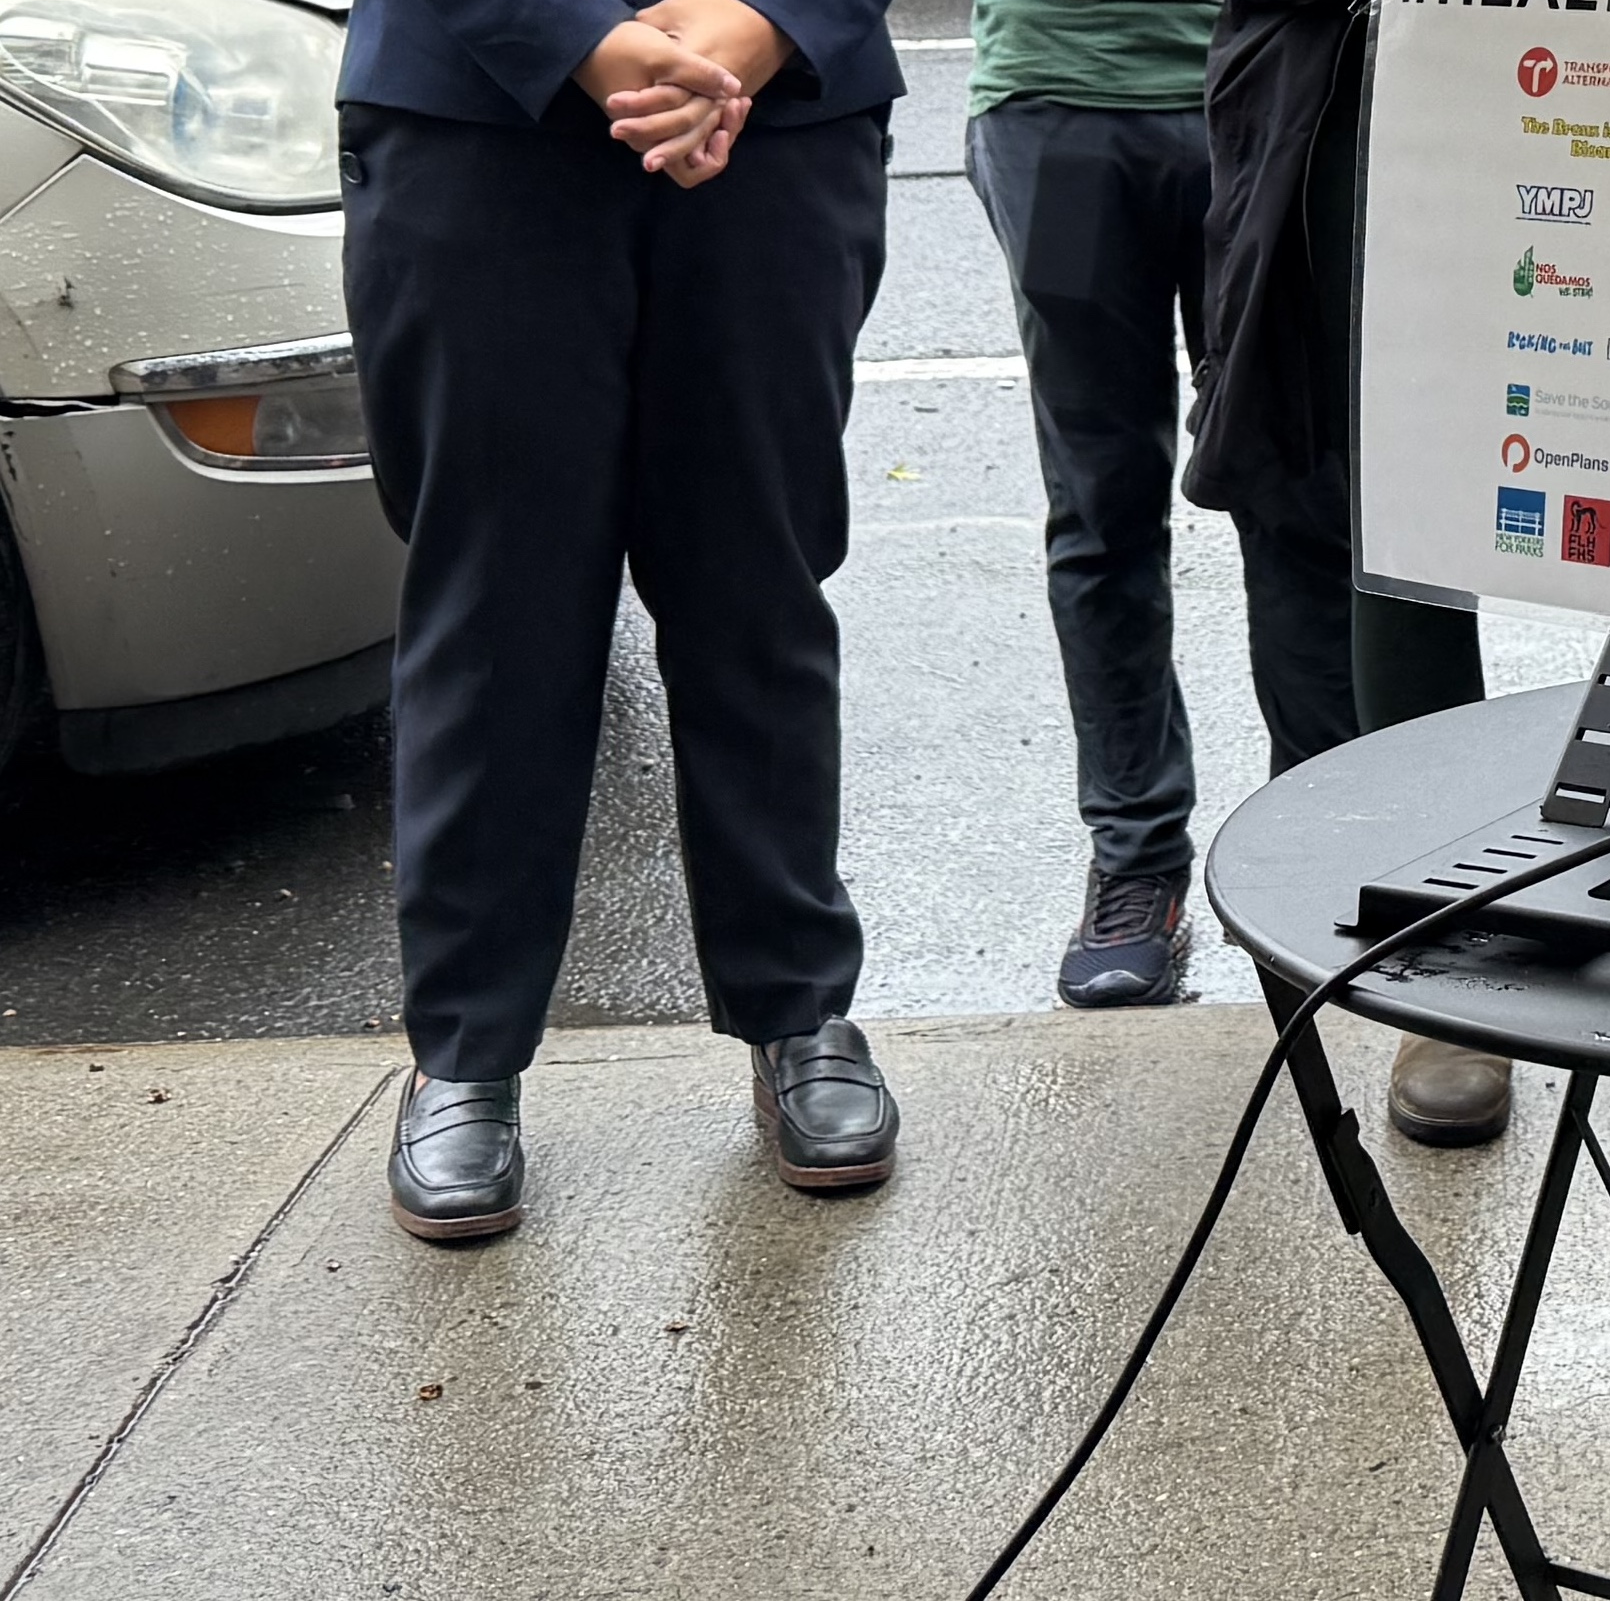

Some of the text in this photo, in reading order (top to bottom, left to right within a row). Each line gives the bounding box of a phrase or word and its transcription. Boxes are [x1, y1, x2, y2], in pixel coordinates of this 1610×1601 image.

[1521, 116, 1549, 134] The
[1552, 118, 1600, 138] Bronx
[1516, 184, 1594, 219] YMPJ
[1536, 264, 1557, 275] NOS
[1535, 274, 1591, 287] QUEDAMOS
[1535, 390, 1565, 404] Save
[1568, 393, 1590, 407] the
[1534, 448, 1609, 472] OpenPlans
[1569, 535, 1595, 548] FLH
[1568, 547, 1595, 562] FHS
